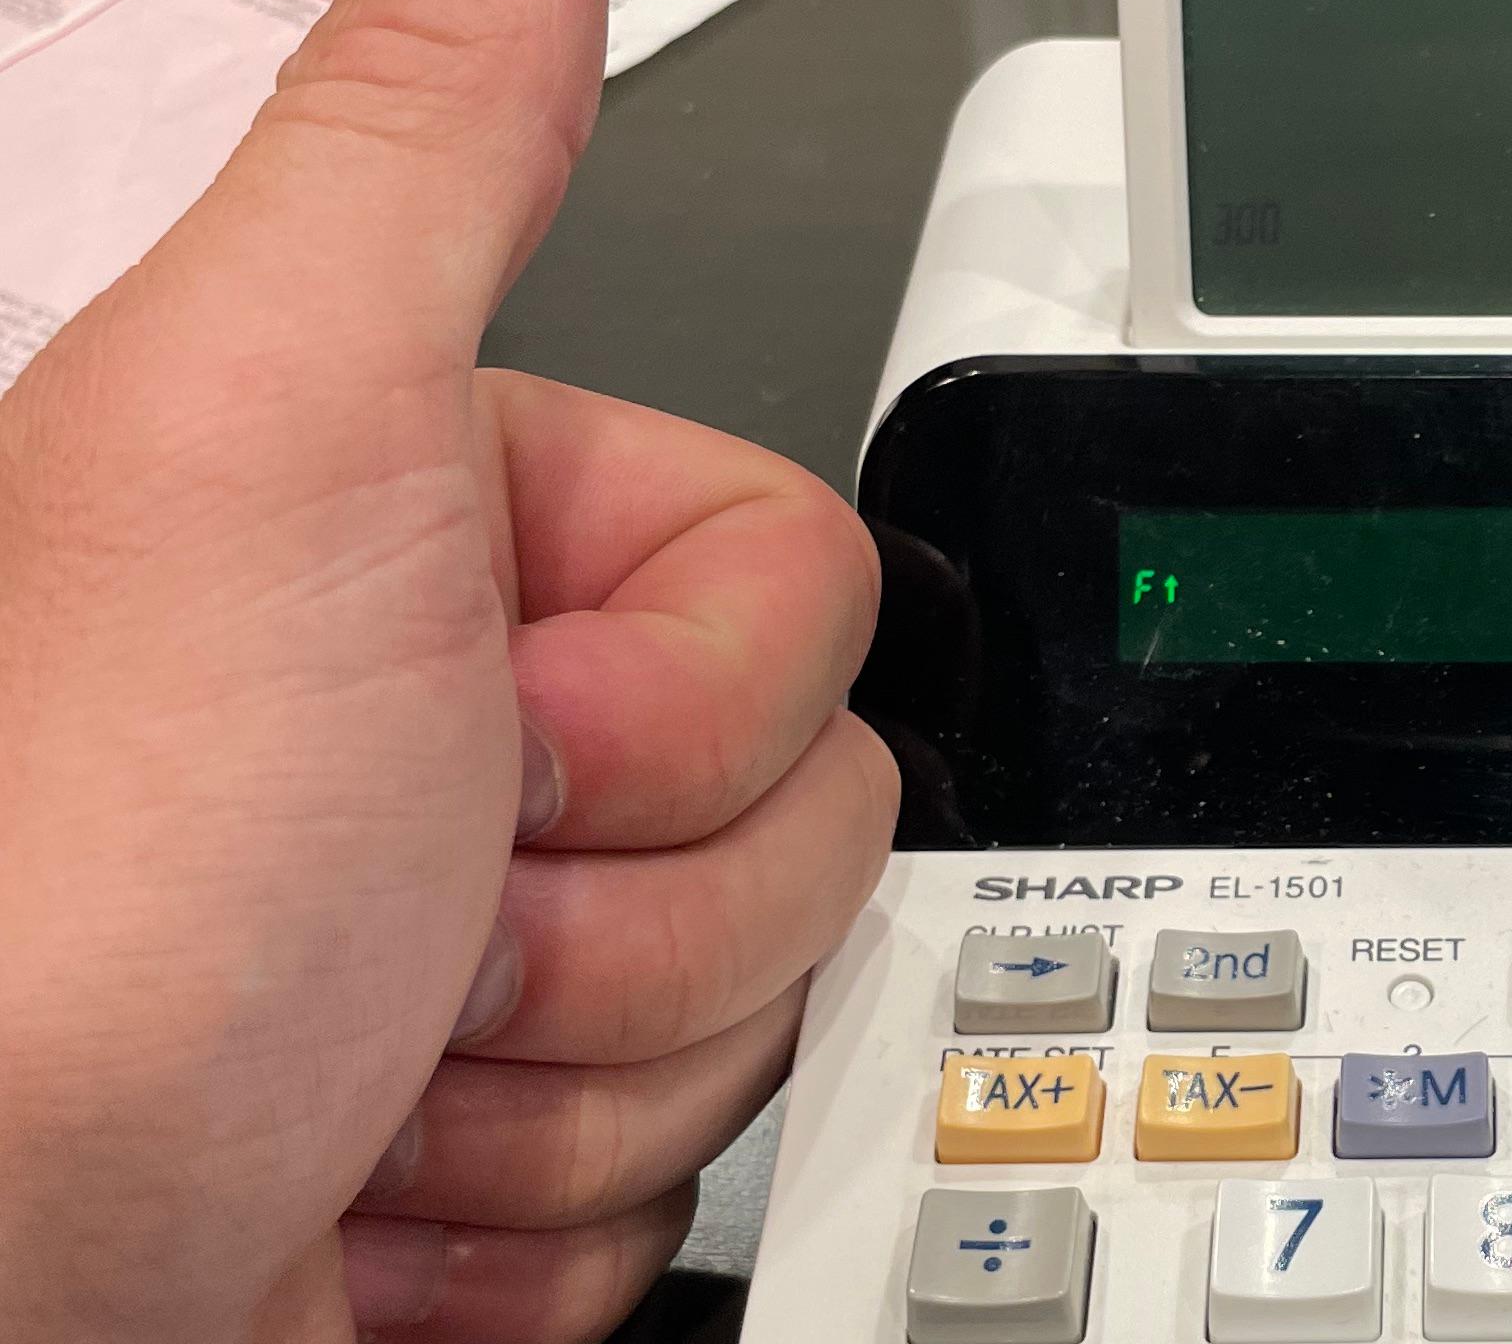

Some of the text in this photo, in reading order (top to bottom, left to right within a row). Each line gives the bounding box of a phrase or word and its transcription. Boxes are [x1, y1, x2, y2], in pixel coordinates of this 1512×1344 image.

[973, 875, 1344, 901] SHARP EL-1501
[1183, 943, 1271, 982] 2nd
[1352, 938, 1466, 962] RESET
[1269, 1198, 1324, 1271] 7
